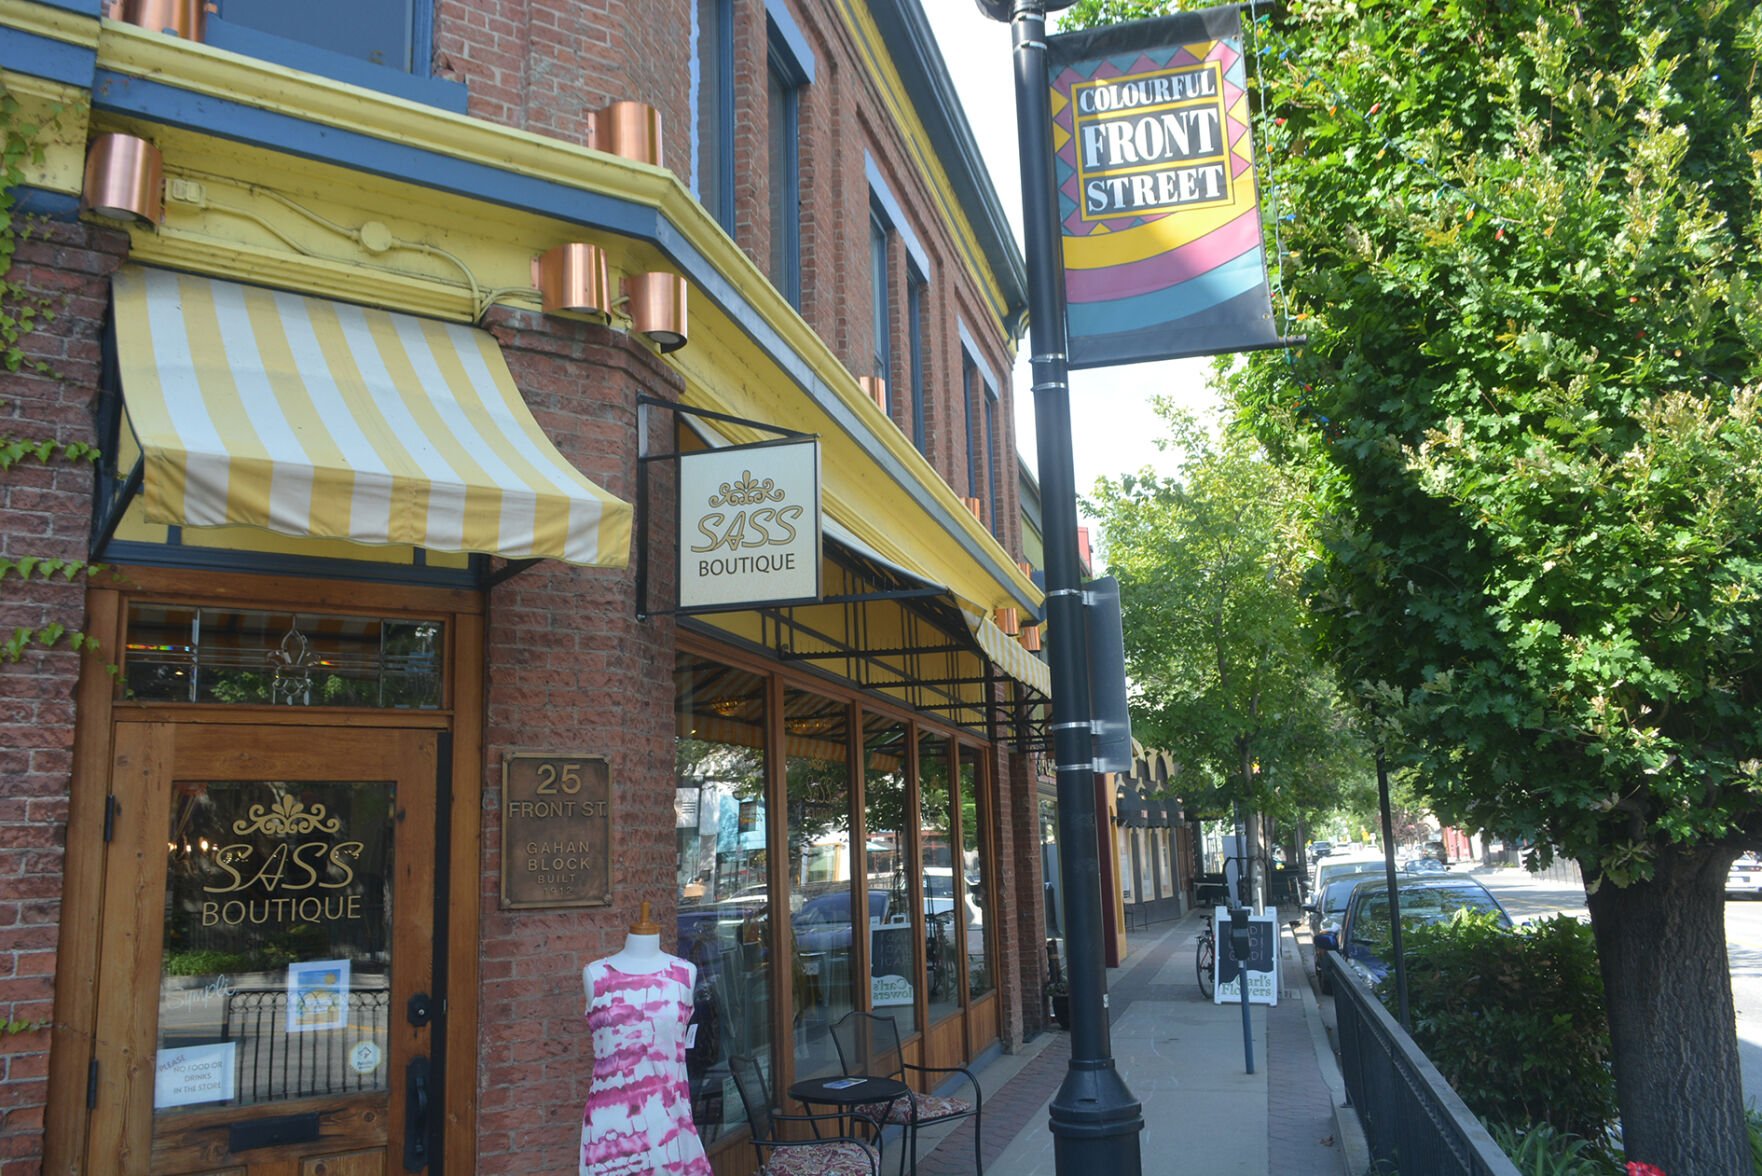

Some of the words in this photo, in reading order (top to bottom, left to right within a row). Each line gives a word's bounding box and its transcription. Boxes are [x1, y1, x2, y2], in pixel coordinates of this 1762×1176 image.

[1080, 70, 1216, 112] COLOURFUL
[1083, 108, 1218, 168] FRONT
[1087, 165, 1223, 212] STREET
[691, 505, 803, 553] SASS
[699, 553, 795, 577] BOUTIQUE
[536, 764, 582, 794] 25
[508, 801, 576, 818] FRONT
[526, 841, 589, 854] GAHAN
[203, 841, 364, 893] SASS
[528, 857, 591, 871] BLOCK
[537, 873, 576, 884] BUILT
[202, 895, 361, 927] BOUTIQUE
[184, 1073, 212, 1082] DRINKS
[188, 1062, 210, 1072] FOOD
[184, 1085, 197, 1094] THE
[198, 1082, 221, 1092] STORE
